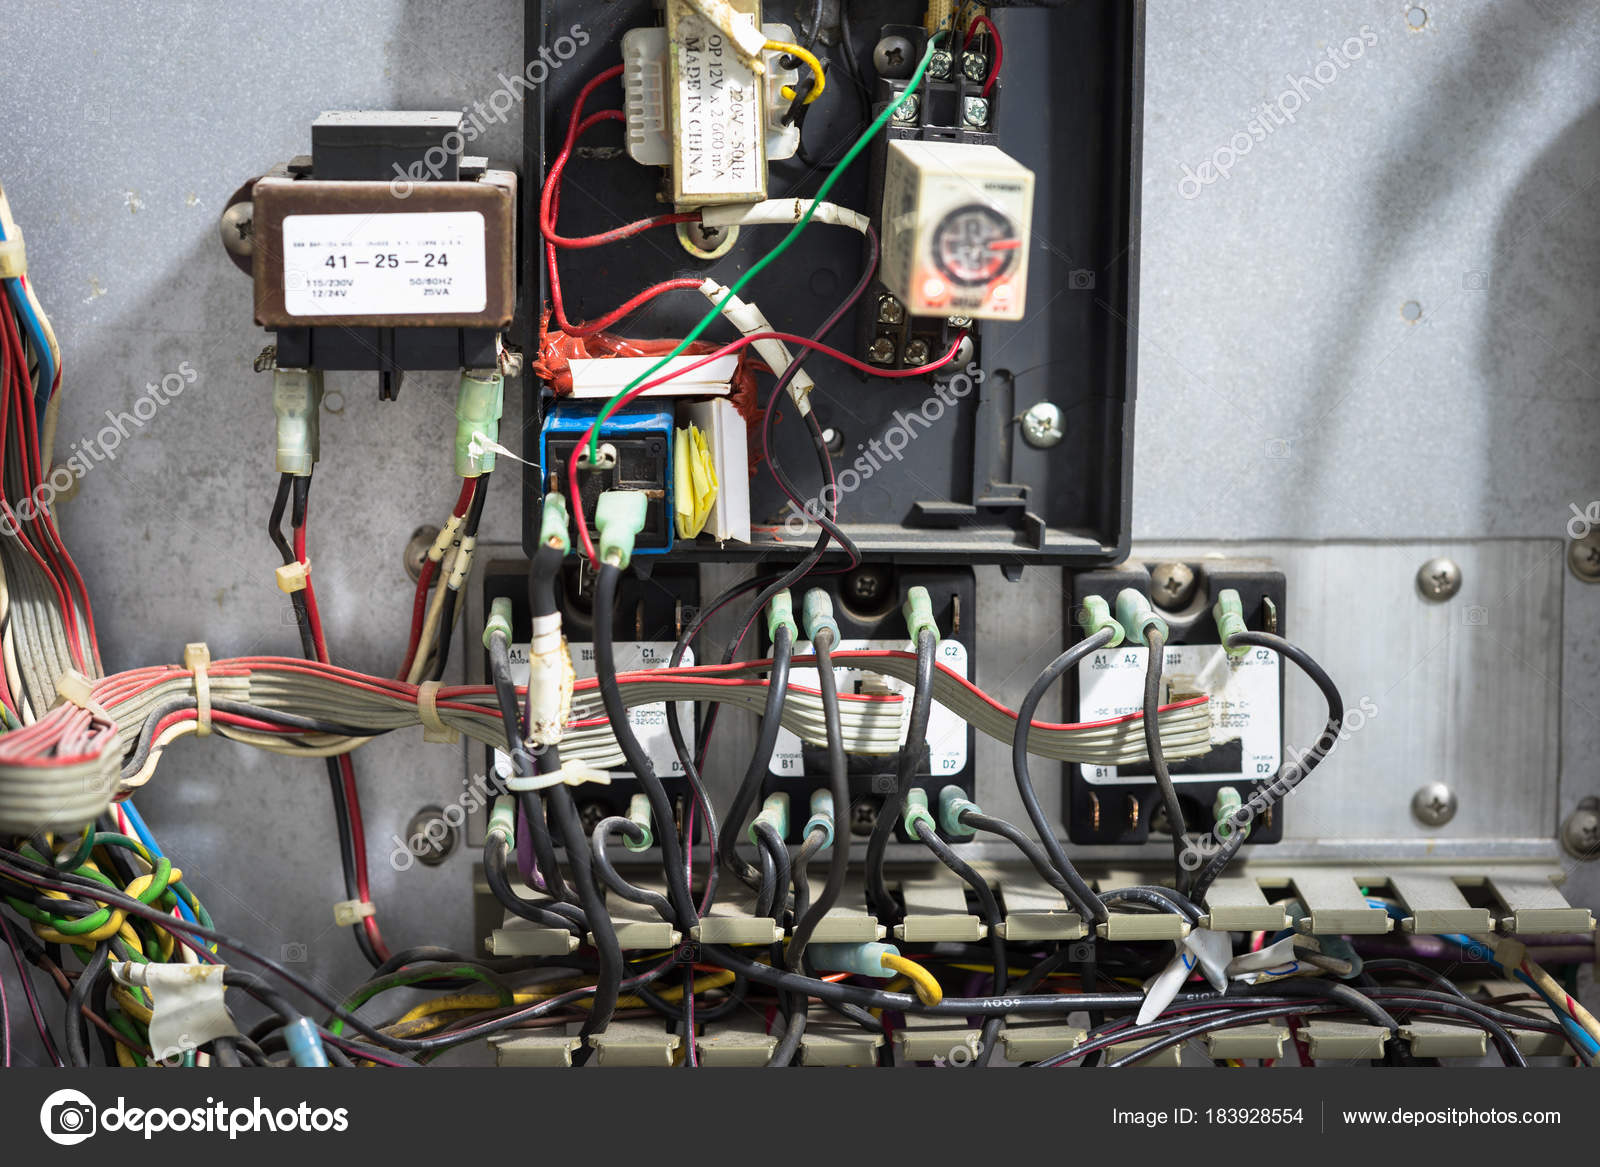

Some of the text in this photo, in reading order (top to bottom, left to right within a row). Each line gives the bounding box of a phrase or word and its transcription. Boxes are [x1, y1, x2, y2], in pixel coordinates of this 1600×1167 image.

[708, 34, 722, 57] OP
[708, 62, 724, 90] 12V
[685, 36, 704, 178] MADE IN CHINA
[509, 650, 522, 659] A1
[642, 648, 654, 657] C1
[945, 647, 958, 656] C2
[1256, 650, 1270, 660] C2
[1094, 655, 1107, 664] A1
[1124, 654, 1138, 664] A2
[782, 759, 794, 769] B1
[943, 759, 957, 769] D2
[1256, 763, 1271, 773] D2
[1095, 767, 1108, 777] B1
